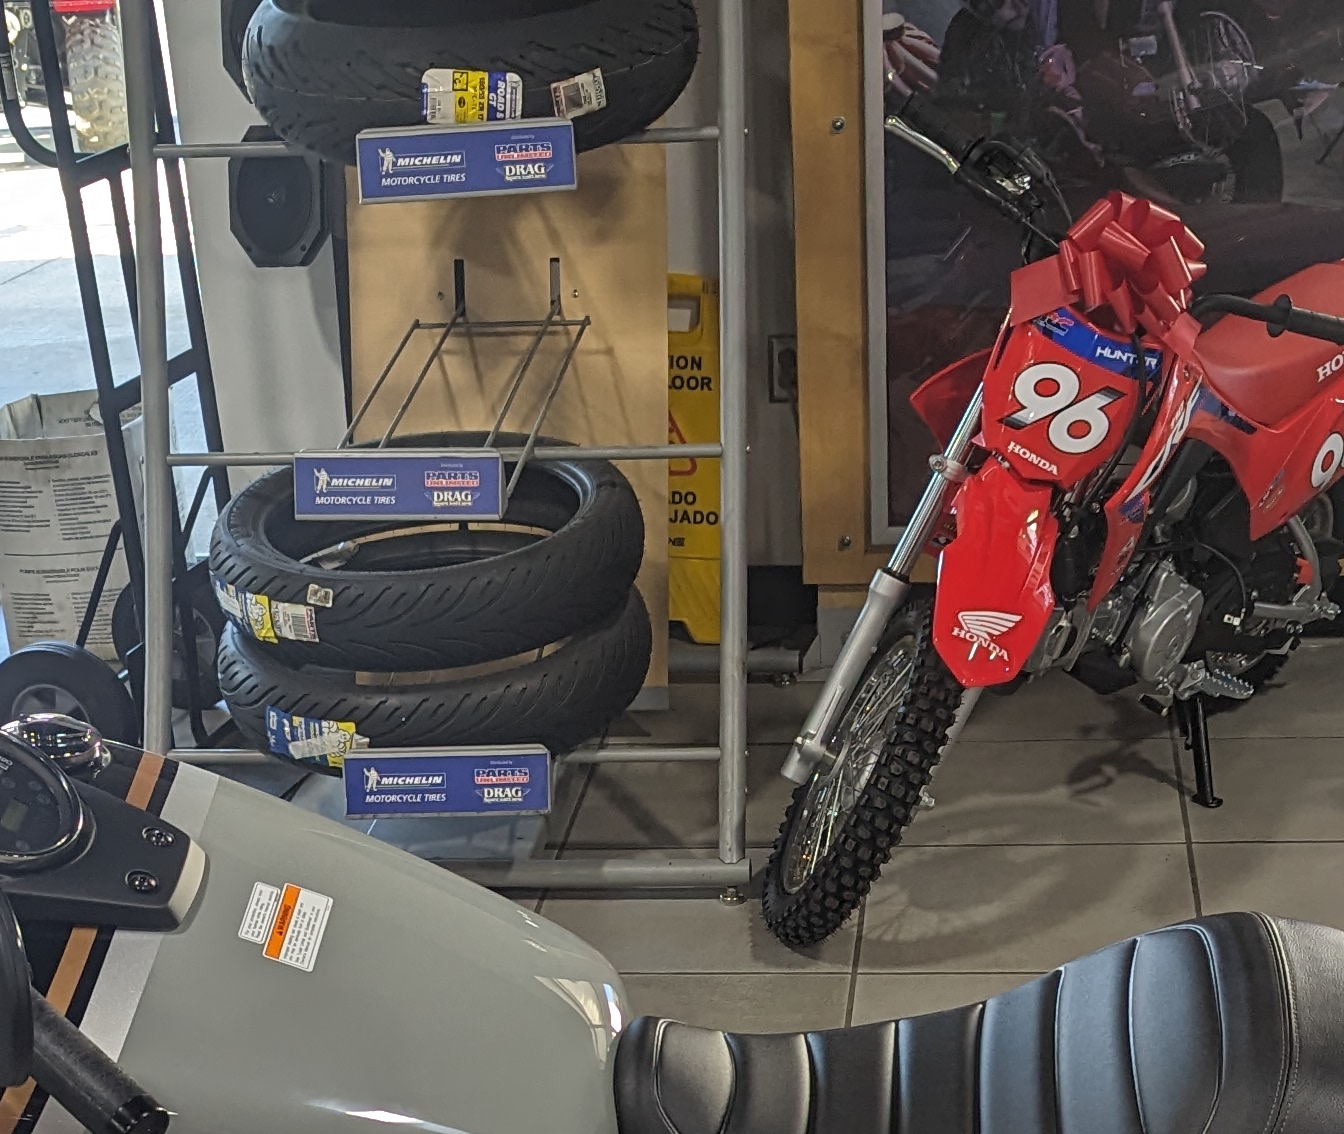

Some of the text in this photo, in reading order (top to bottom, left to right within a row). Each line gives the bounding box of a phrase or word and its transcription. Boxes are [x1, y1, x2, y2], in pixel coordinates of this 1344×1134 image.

[489, 92, 497, 107] GT
[497, 80, 506, 111] ROAD
[496, 142, 552, 154] PARTS
[396, 153, 461, 167] MICHELIN
[505, 163, 545, 176] DRAG
[381, 173, 466, 187] MOTORCYCLE TIRES
[668, 375, 713, 391] OOR
[997, 361, 1128, 455] 96
[1007, 440, 1058, 475] HONDA
[330, 476, 394, 488] MICHELIN
[425, 471, 479, 480] PARTS
[315, 495, 396, 505] MOTORCYCLE TIRES
[433, 491, 472, 502] DRAG
[668, 509, 719, 526] JADO
[951, 627, 1009, 661] HONDA
[380, 774, 443, 785] MICHELIN
[474, 768, 530, 778] PARTS
[365, 792, 446, 803] MOTORCYCLE TIRES
[484, 786, 522, 798] DRAG
